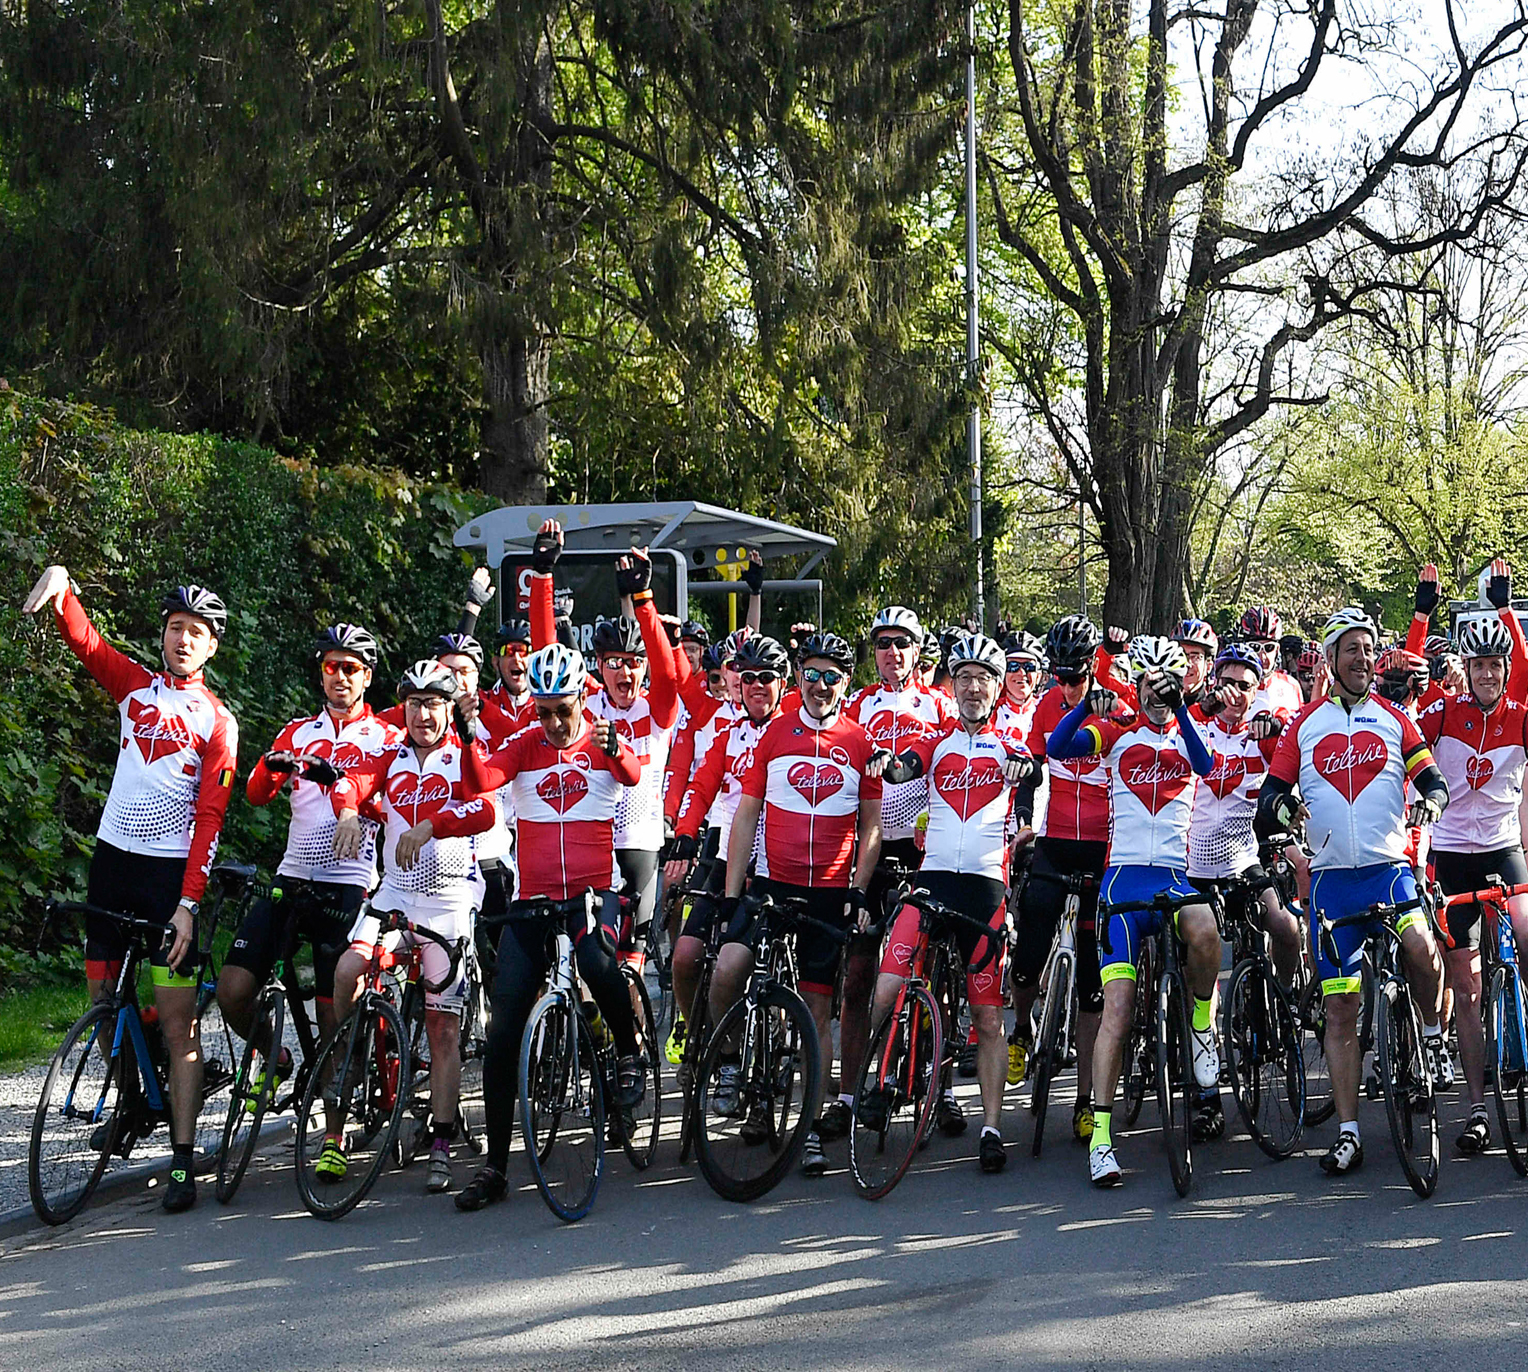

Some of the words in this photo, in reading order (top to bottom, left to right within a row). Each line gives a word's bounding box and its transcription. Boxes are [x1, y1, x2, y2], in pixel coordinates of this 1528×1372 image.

[1322, 742, 1386, 775] télévie
[1127, 761, 1188, 785] télévie
[450, 797, 485, 820] Lotto
